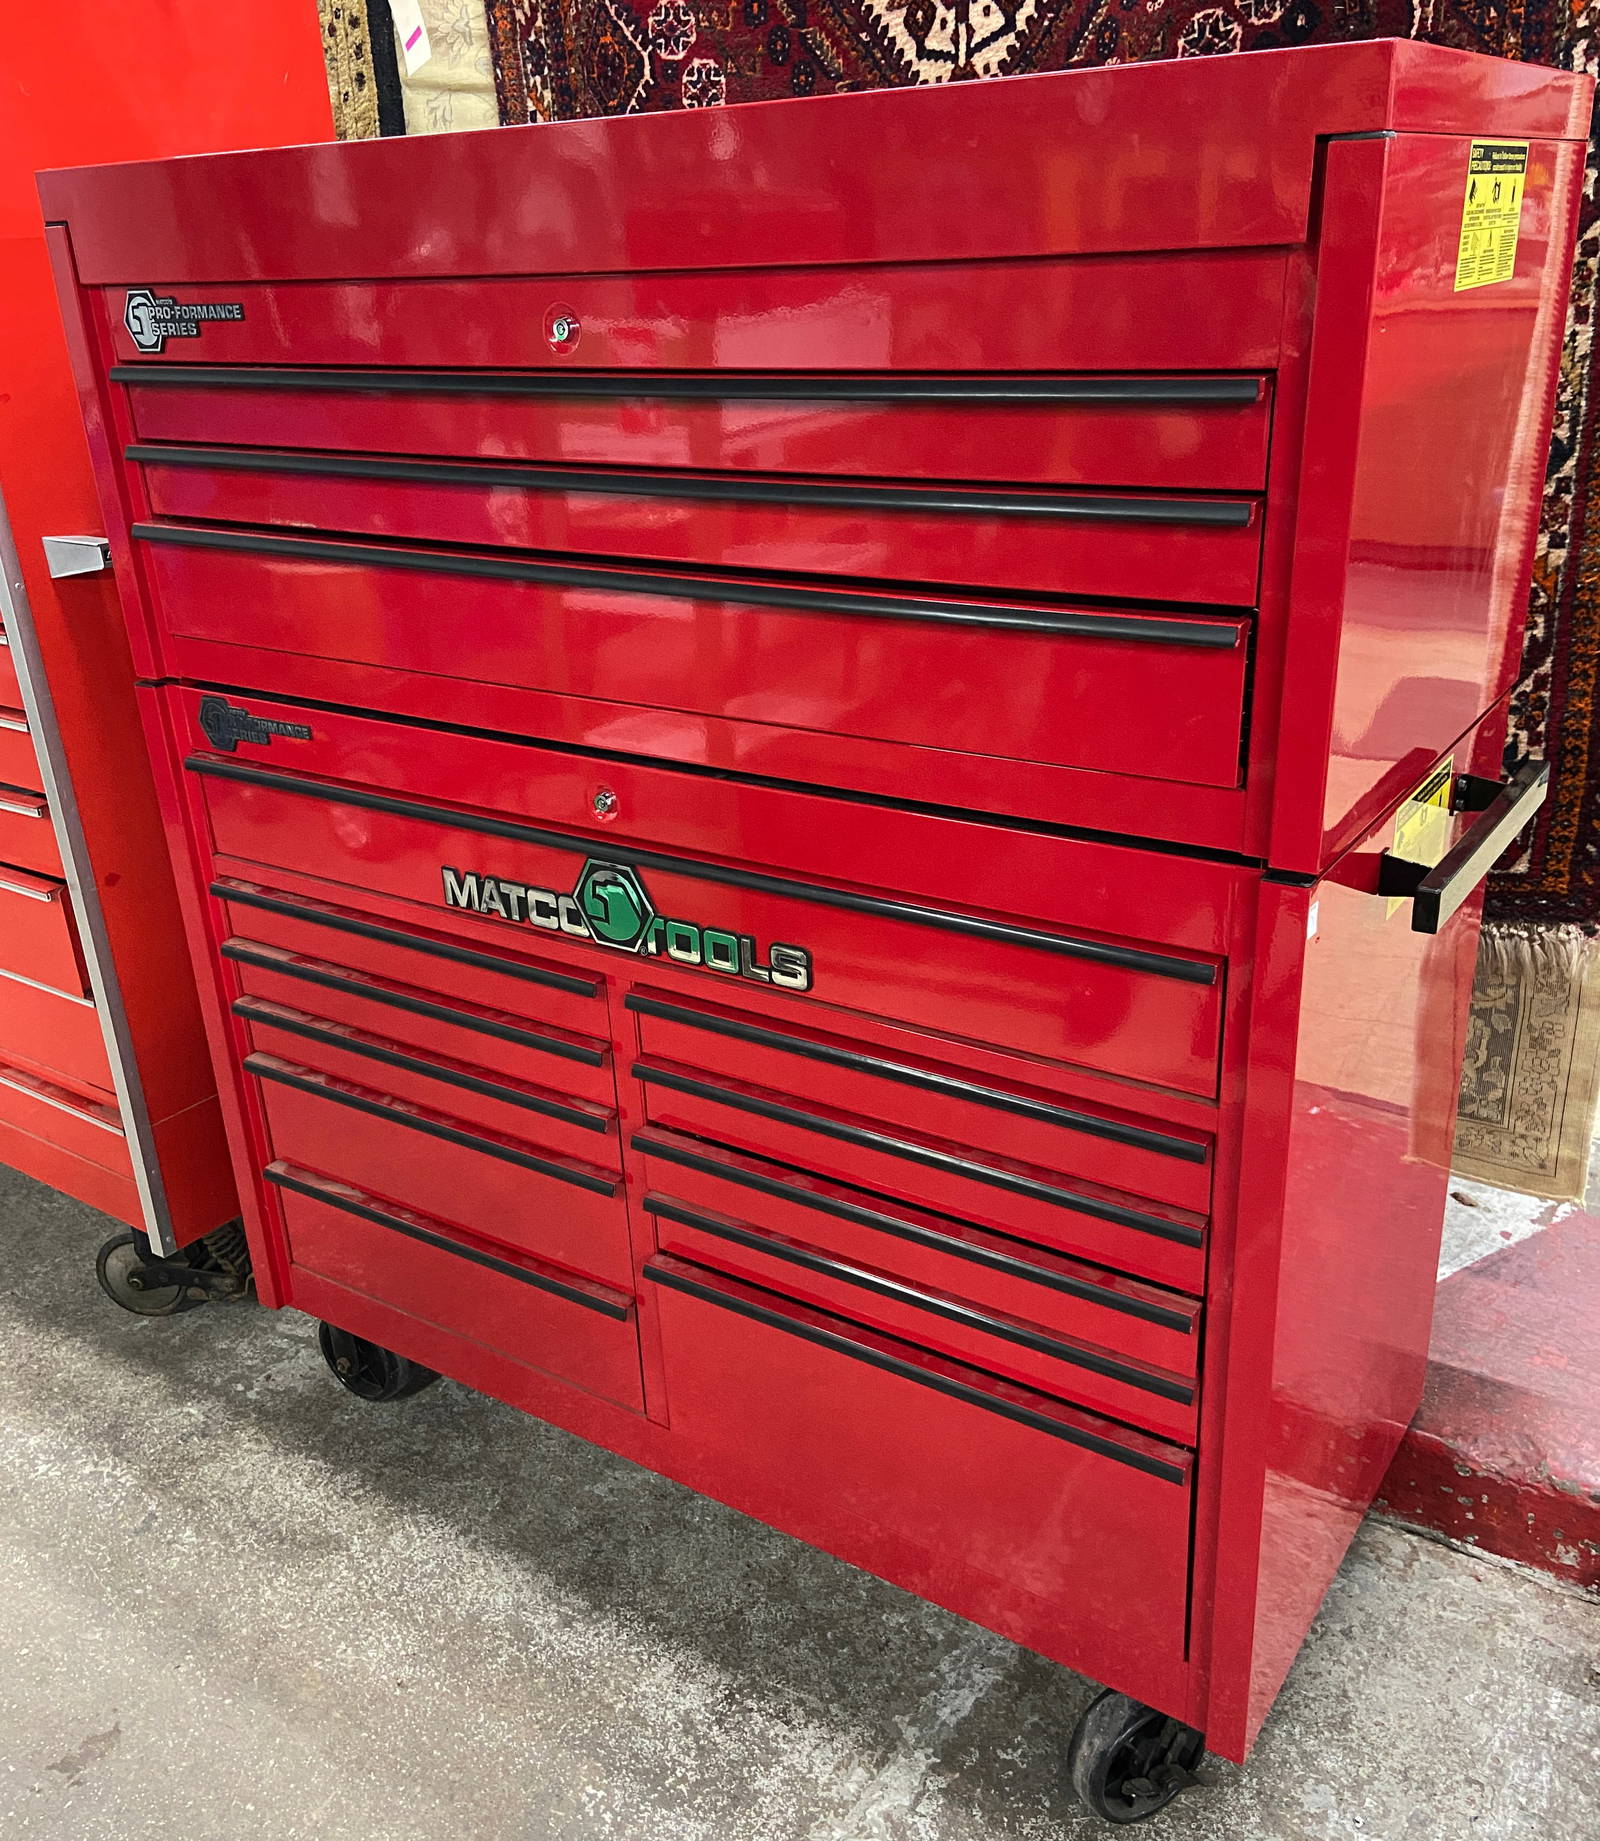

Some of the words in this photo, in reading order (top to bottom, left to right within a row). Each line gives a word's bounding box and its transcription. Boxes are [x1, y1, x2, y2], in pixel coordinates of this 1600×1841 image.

[152, 322, 197, 336] SERIES
[441, 866, 589, 938] MATCO
[647, 917, 810, 991] TOOLS
